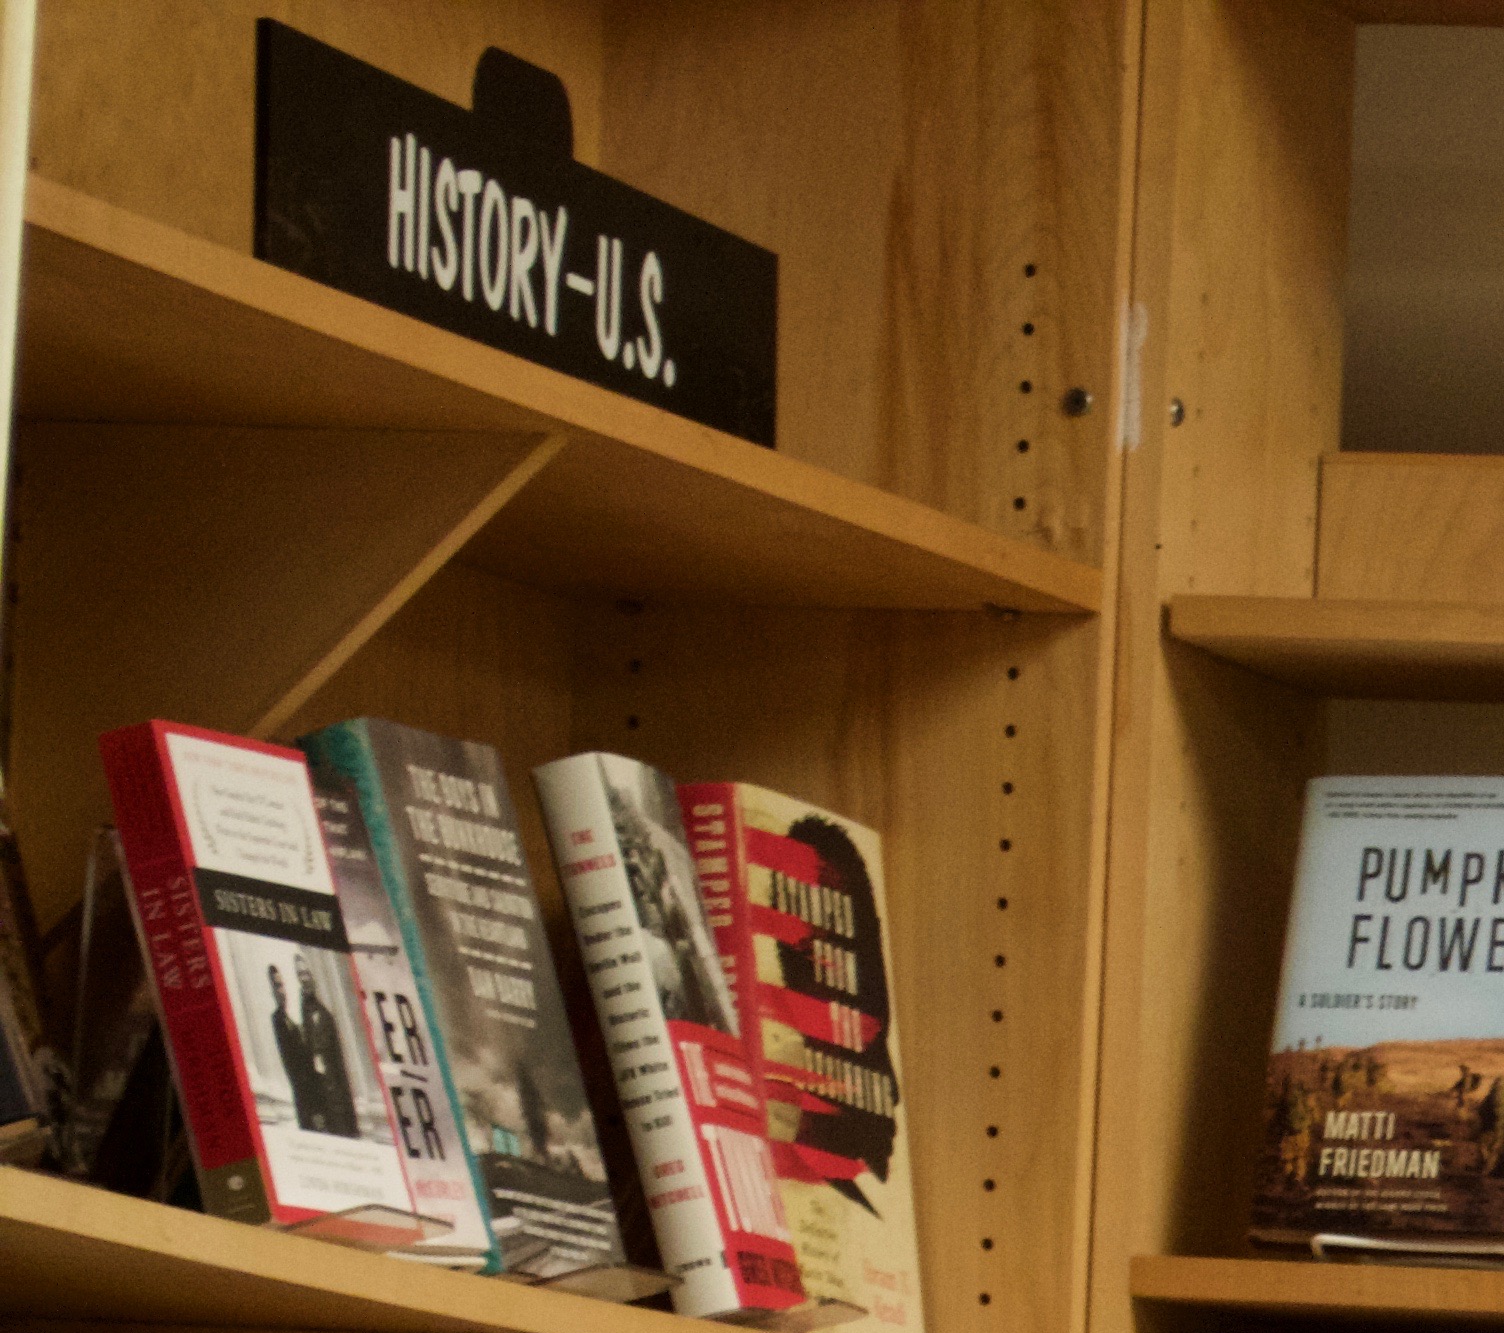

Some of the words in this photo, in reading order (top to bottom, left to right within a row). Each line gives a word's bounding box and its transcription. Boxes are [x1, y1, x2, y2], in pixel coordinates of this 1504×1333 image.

[388, 132, 676, 388] HISTORY-U.S.
[1323, 1110, 1396, 1140] MATTI
[1319, 1148, 1442, 1180] FRIEDMAN
